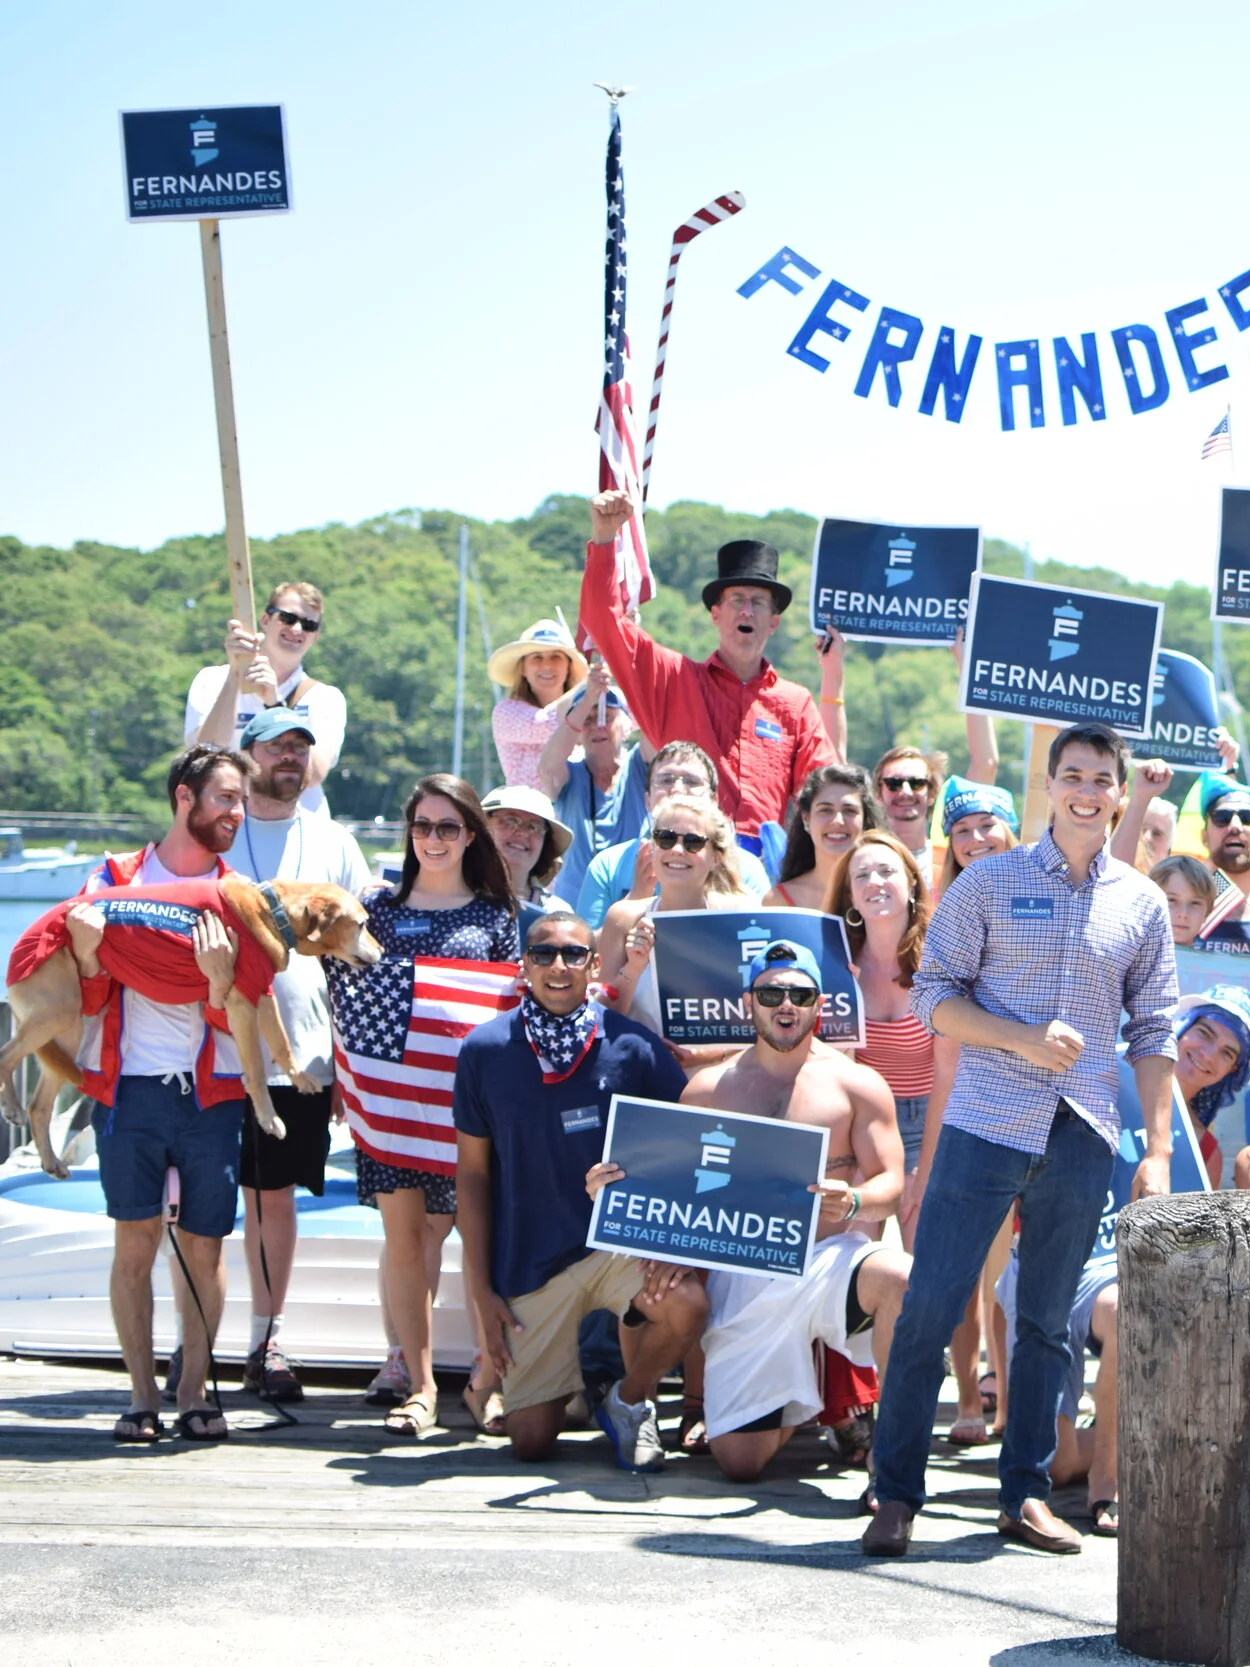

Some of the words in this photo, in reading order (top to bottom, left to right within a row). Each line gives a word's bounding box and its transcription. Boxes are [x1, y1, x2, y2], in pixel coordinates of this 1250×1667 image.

[193, 130, 215, 147] F
[132, 170, 282, 196] FERNANDES
[150, 198, 183, 209] STATE
[185, 193, 282, 208] REPRESENTATIVE
[889, 549, 913, 566] F
[818, 588, 969, 620] FERNANDES
[832, 614, 866, 629] STATE
[869, 618, 967, 634] REPRESENTATIV
[1053, 618, 1080, 637] F
[974, 660, 1142, 706] FERNANDES
[990, 690, 1026, 706] STATE
[1030, 696, 1140, 723] REPRESENTATIVE
[109, 901, 199, 925] FERNANDES
[666, 992, 852, 1021] FERNES
[668, 1025, 685, 1033] FOR
[687, 1024, 727, 1037] STATE
[701, 1144, 731, 1167] F
[606, 1190, 803, 1246] FERNANDES
[603, 1221, 622, 1231] FOR
[623, 1225, 666, 1244] STATE
[670, 1233, 799, 1266] REPRESENTATIVE
